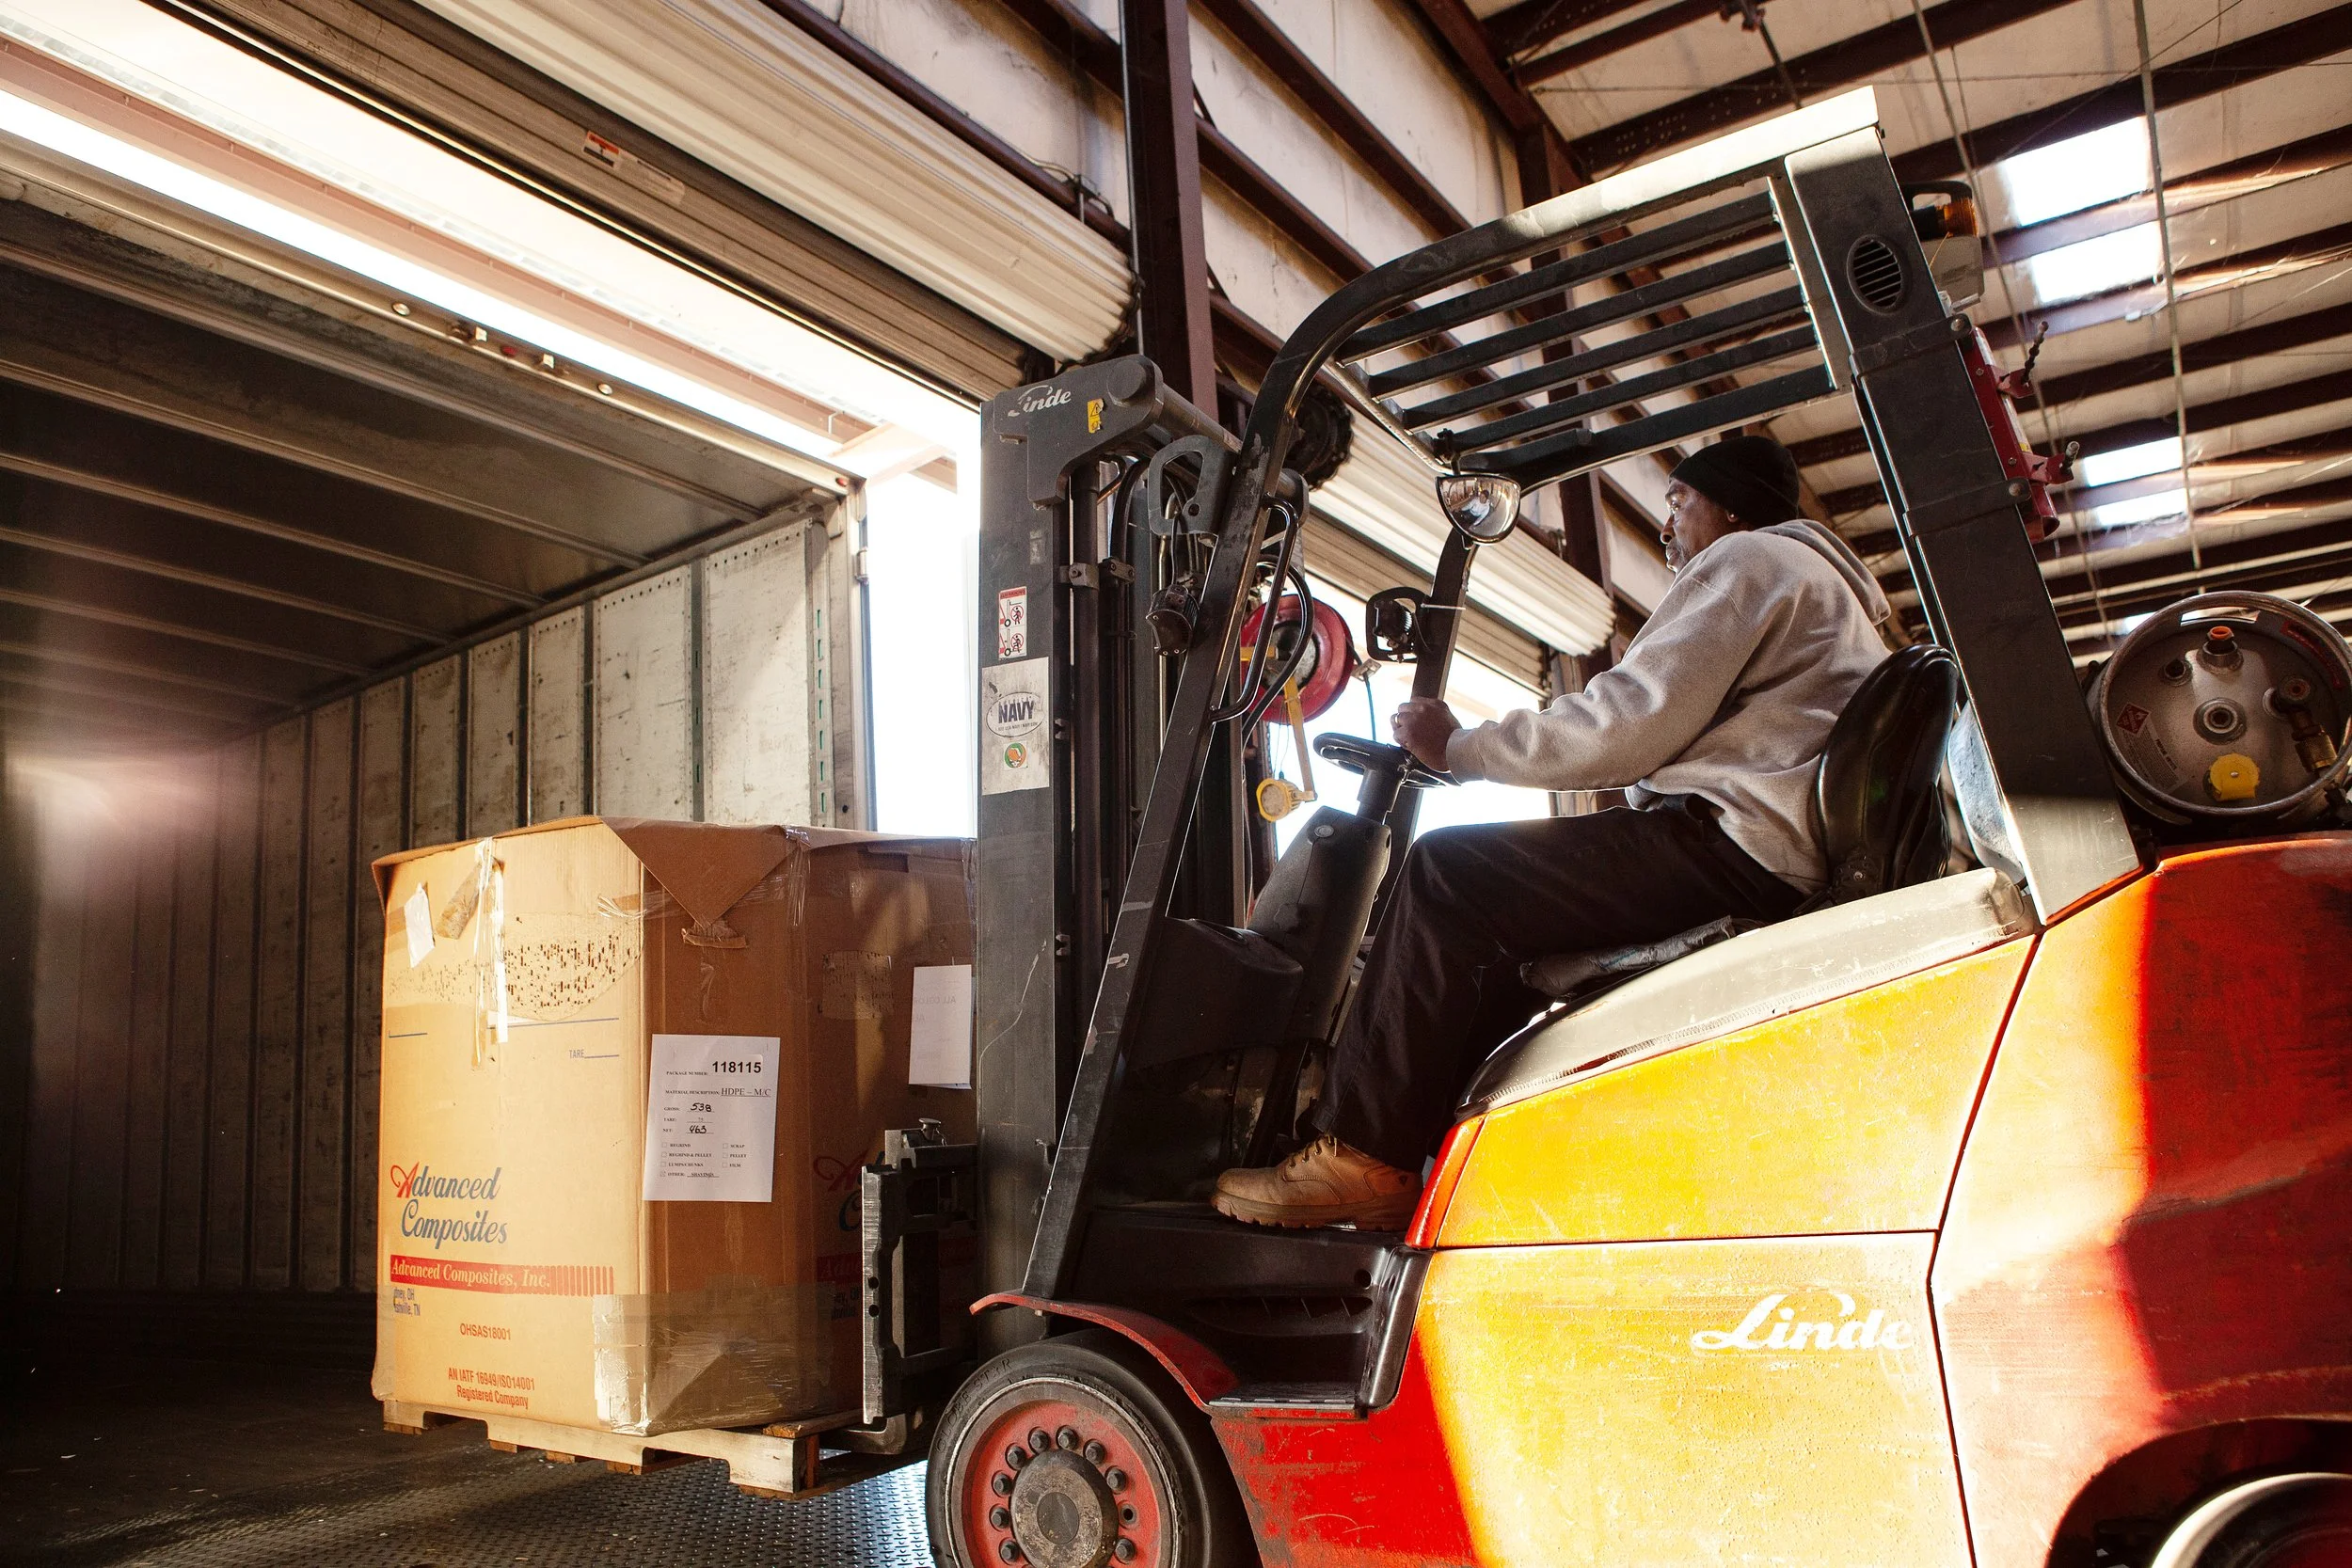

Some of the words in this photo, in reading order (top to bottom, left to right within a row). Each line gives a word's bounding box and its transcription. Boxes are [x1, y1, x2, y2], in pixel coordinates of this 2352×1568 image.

[998, 700, 1035, 724] NAVY
[568, 1049, 585, 1059] TARE
[712, 1061, 762, 1073] 118115
[721, 1087, 745, 1096] HDPE
[691, 1102, 712, 1112] 538
[390, 1162, 501, 1199] Advanced
[402, 1198, 508, 1250] Composites
[391, 1259, 440, 1280] Advanced
[443, 1264, 517, 1290] Composites,
[522, 1269, 550, 1288] Inc.
[407, 1288, 415, 1301] OH
[414, 1304, 421, 1316] TN
[459, 1323, 511, 1340] OHSAS18001
[1691, 1293, 1913, 1350] Linde
[448, 1368, 458, 1381] AN
[459, 1369, 474, 1383] IATF
[476, 1371, 535, 1391] 16949/ISO14001
[456, 1385, 494, 1402] Registered
[495, 1390, 529, 1410] Company
